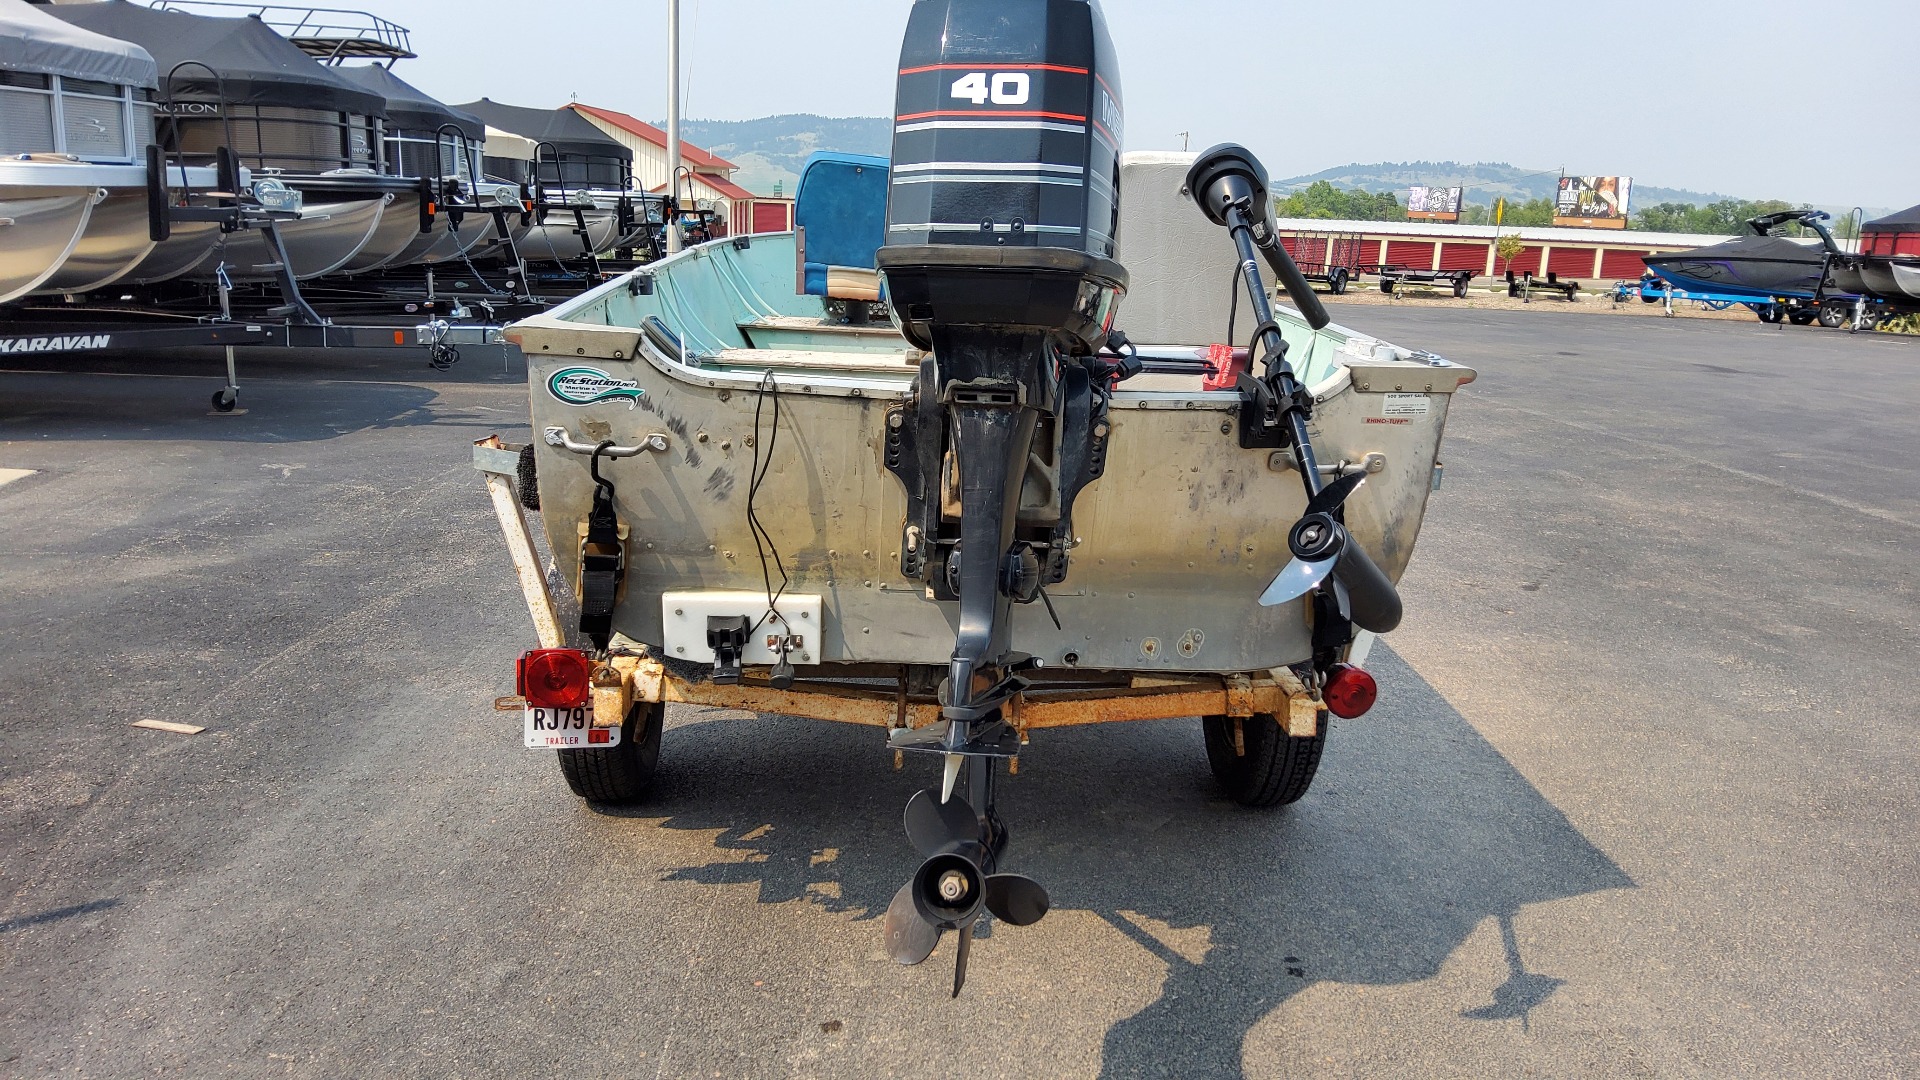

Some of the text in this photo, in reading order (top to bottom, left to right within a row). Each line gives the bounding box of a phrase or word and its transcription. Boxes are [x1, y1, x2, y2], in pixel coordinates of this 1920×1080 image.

[951, 72, 1029, 105] 40
[0, 334, 110, 353] KARAVAN
[557, 376, 636, 388] RecStation.net
[533, 708, 610, 730] RJ797
[545, 736, 579, 745] TRAILER
